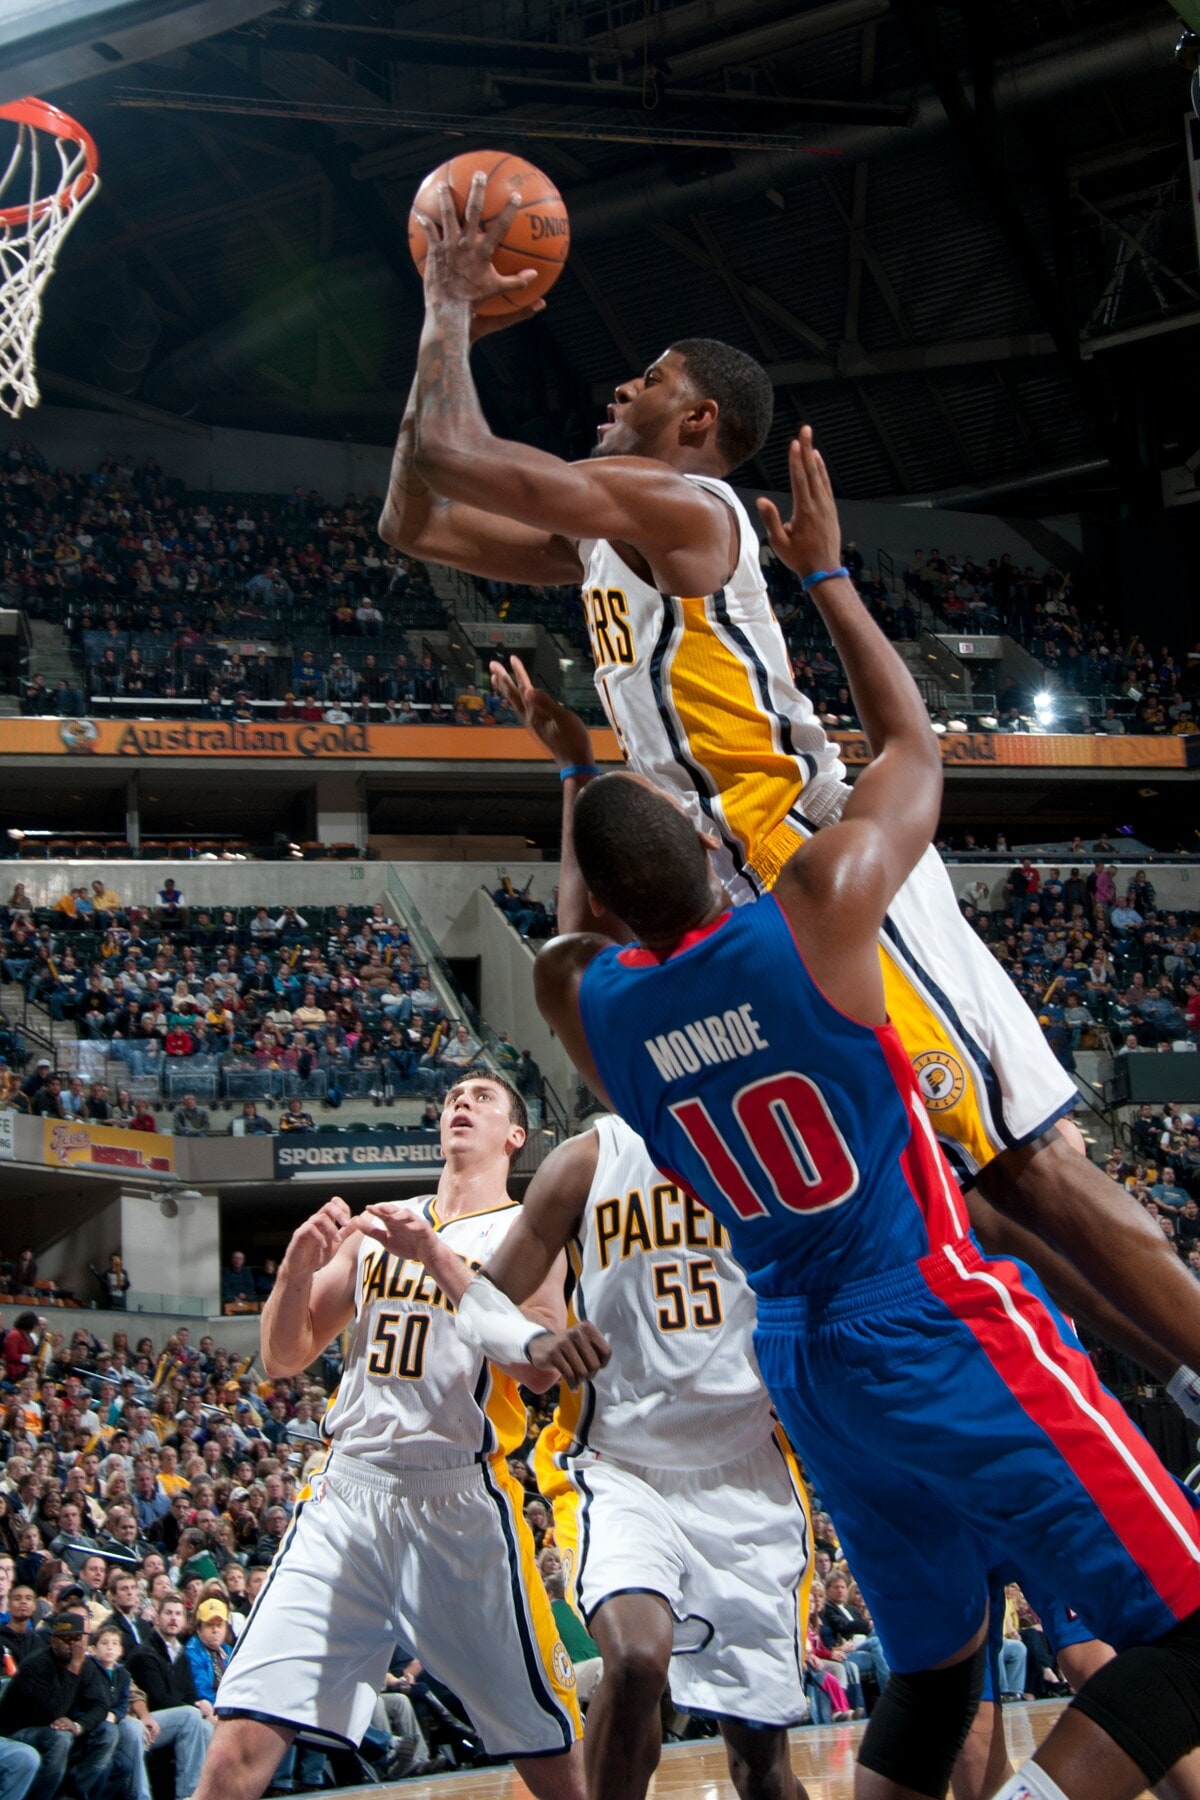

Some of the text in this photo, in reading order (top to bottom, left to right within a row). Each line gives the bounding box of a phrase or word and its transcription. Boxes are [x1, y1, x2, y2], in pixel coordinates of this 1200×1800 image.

[117, 722, 373, 757] Australian Gold
[644, 1003, 769, 1083] MONROE
[279, 1144, 444, 1166] SPORT GRAPHIC
[667, 1070, 860, 1221] 10
[594, 1181, 732, 1271] PACE
[652, 1257, 724, 1333] 55
[367, 1311, 431, 1381] 50
